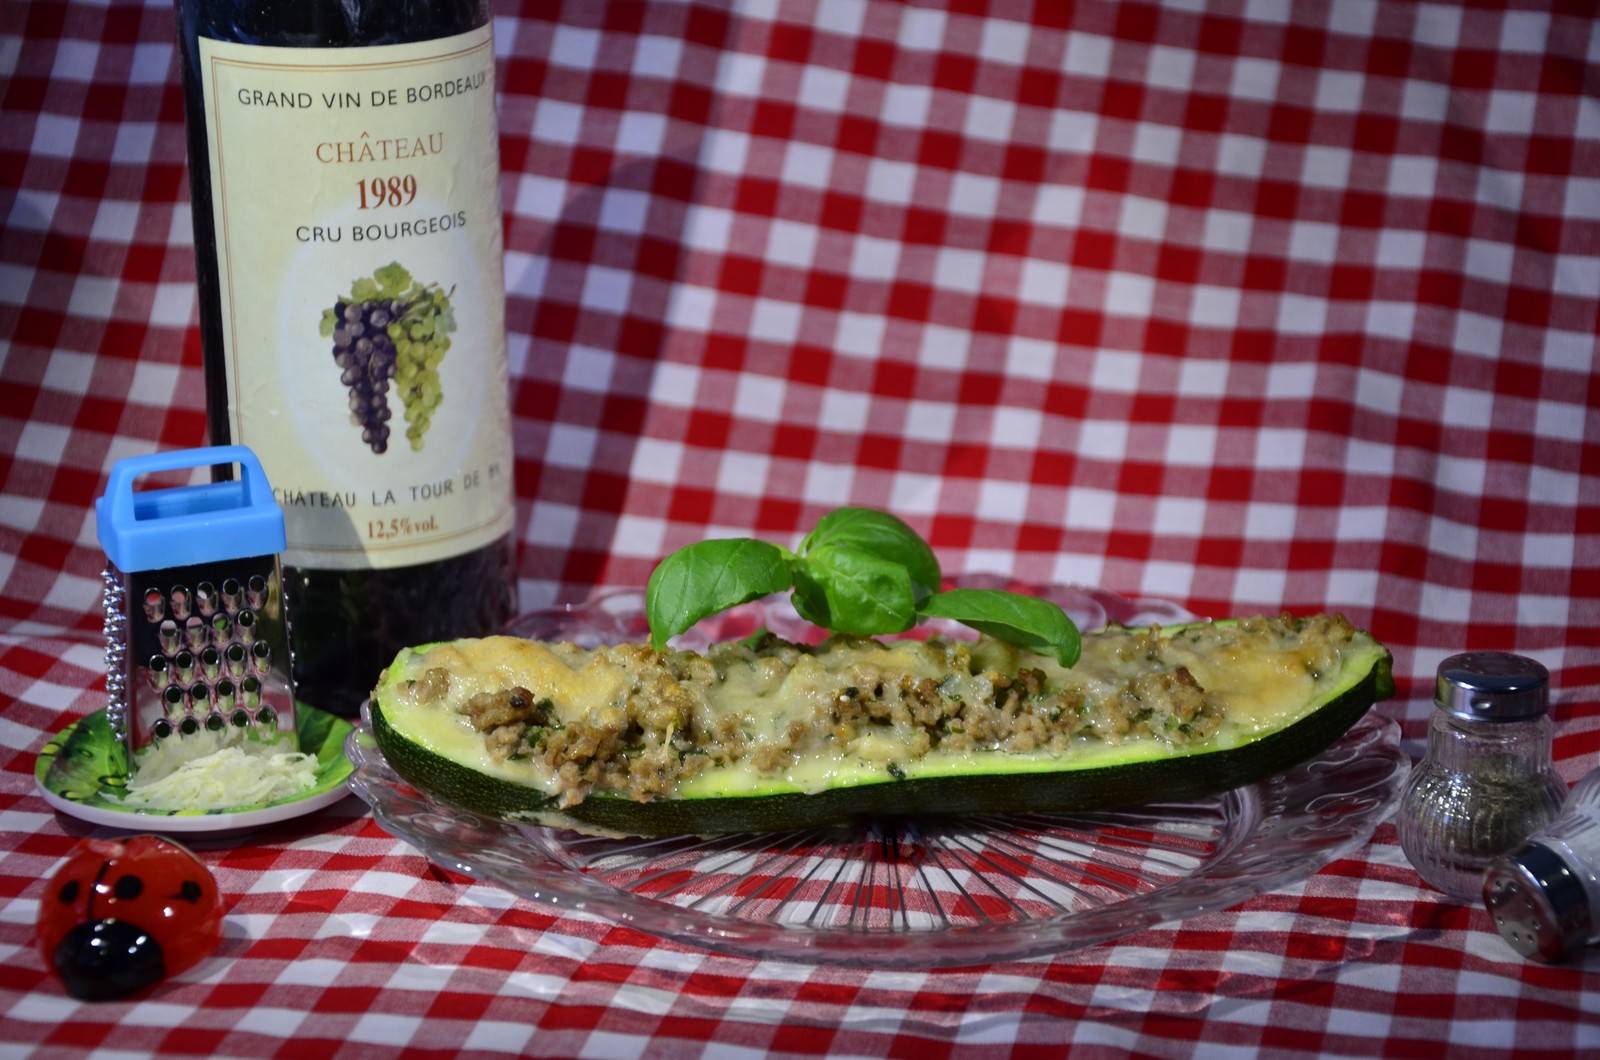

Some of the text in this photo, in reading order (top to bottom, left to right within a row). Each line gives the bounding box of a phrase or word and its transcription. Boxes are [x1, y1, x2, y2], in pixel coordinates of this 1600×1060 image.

[238, 88, 313, 109] GRAND
[321, 92, 361, 109] VIN
[370, 90, 398, 107] DE
[315, 131, 444, 164] CHÂTEAU
[356, 174, 417, 210] 1989
[296, 211, 466, 243] CRU BOURGEOIS
[372, 490, 396, 507] LA
[409, 479, 454, 502] TOUR
[463, 470, 480, 490] DE
